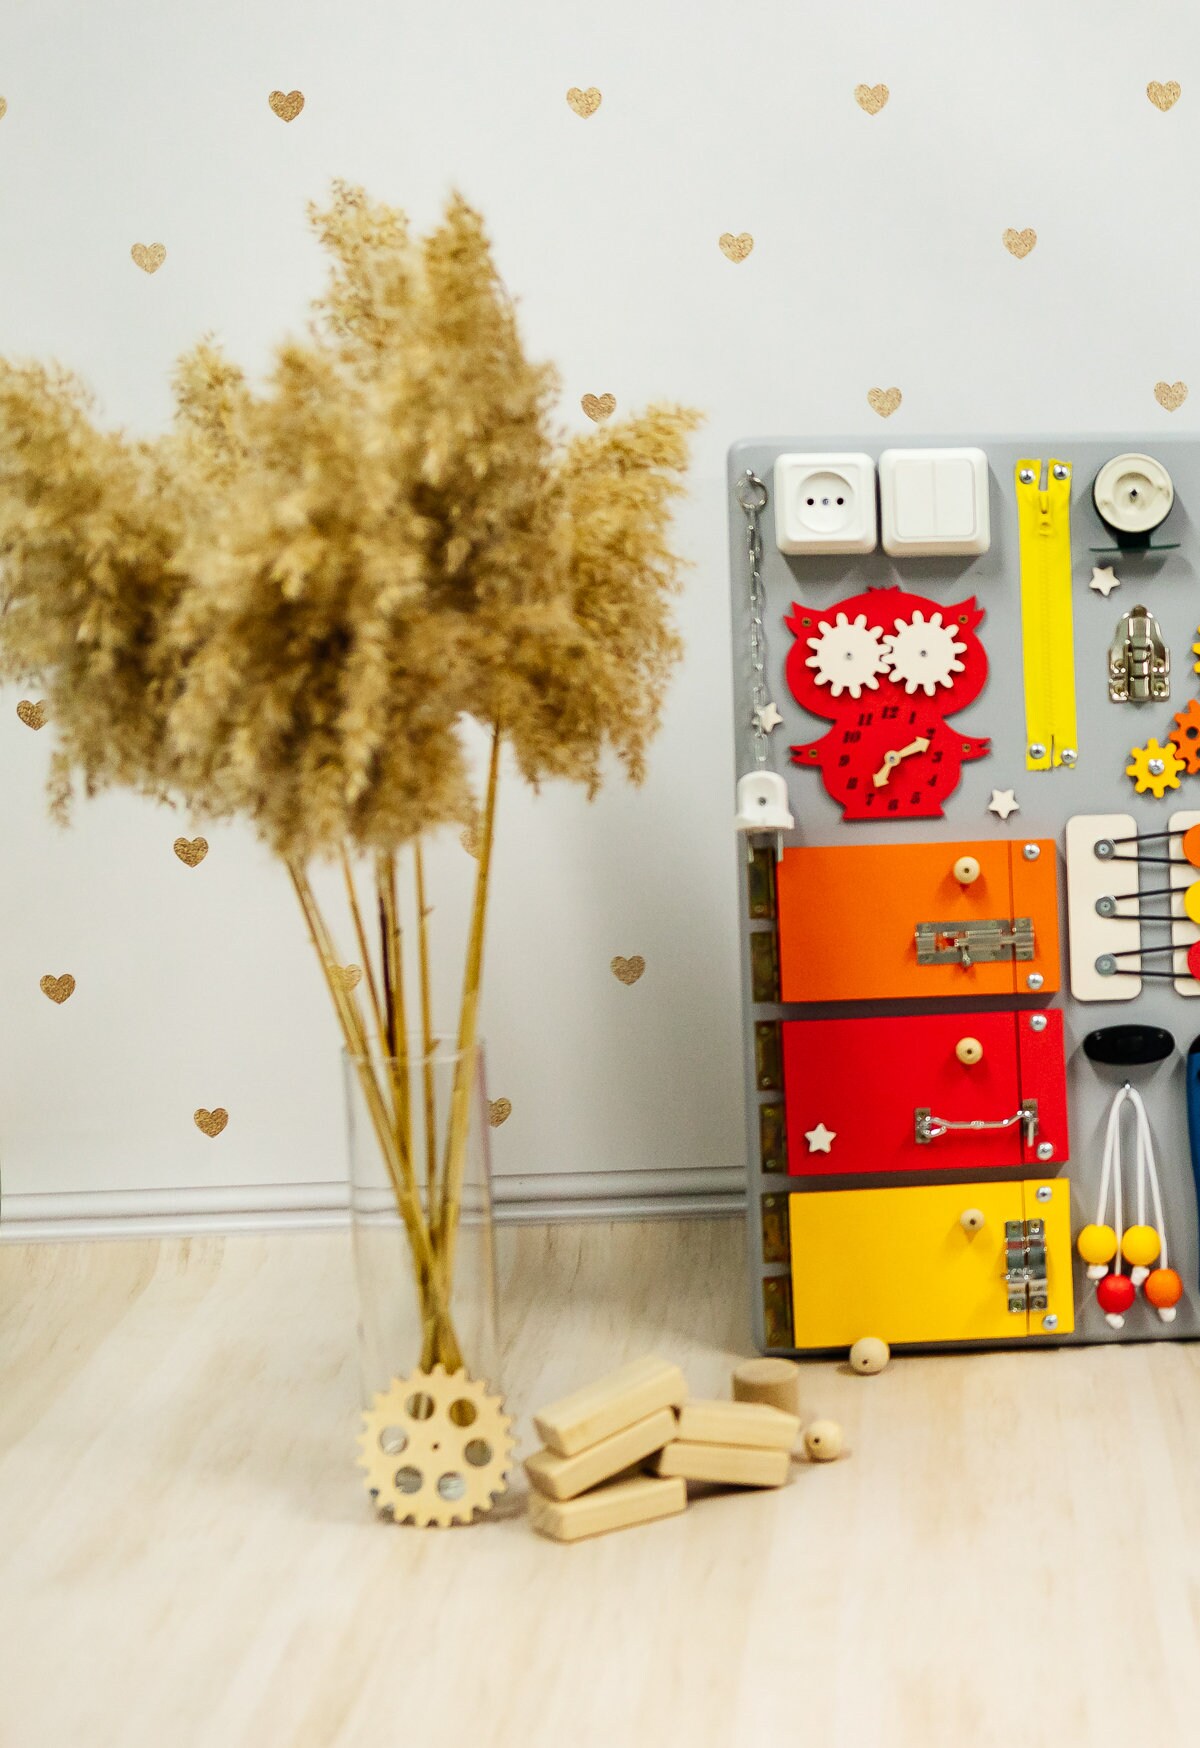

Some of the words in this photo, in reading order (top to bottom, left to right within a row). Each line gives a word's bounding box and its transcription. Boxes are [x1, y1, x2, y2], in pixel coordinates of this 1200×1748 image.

[881, 706, 899, 719] 12
[909, 711, 916, 724] 1
[858, 713, 873, 726] 11
[844, 732, 860, 742] 10
[839, 756, 850, 766] 9
[932, 753, 942, 763] 3
[928, 775, 937, 786] 4
